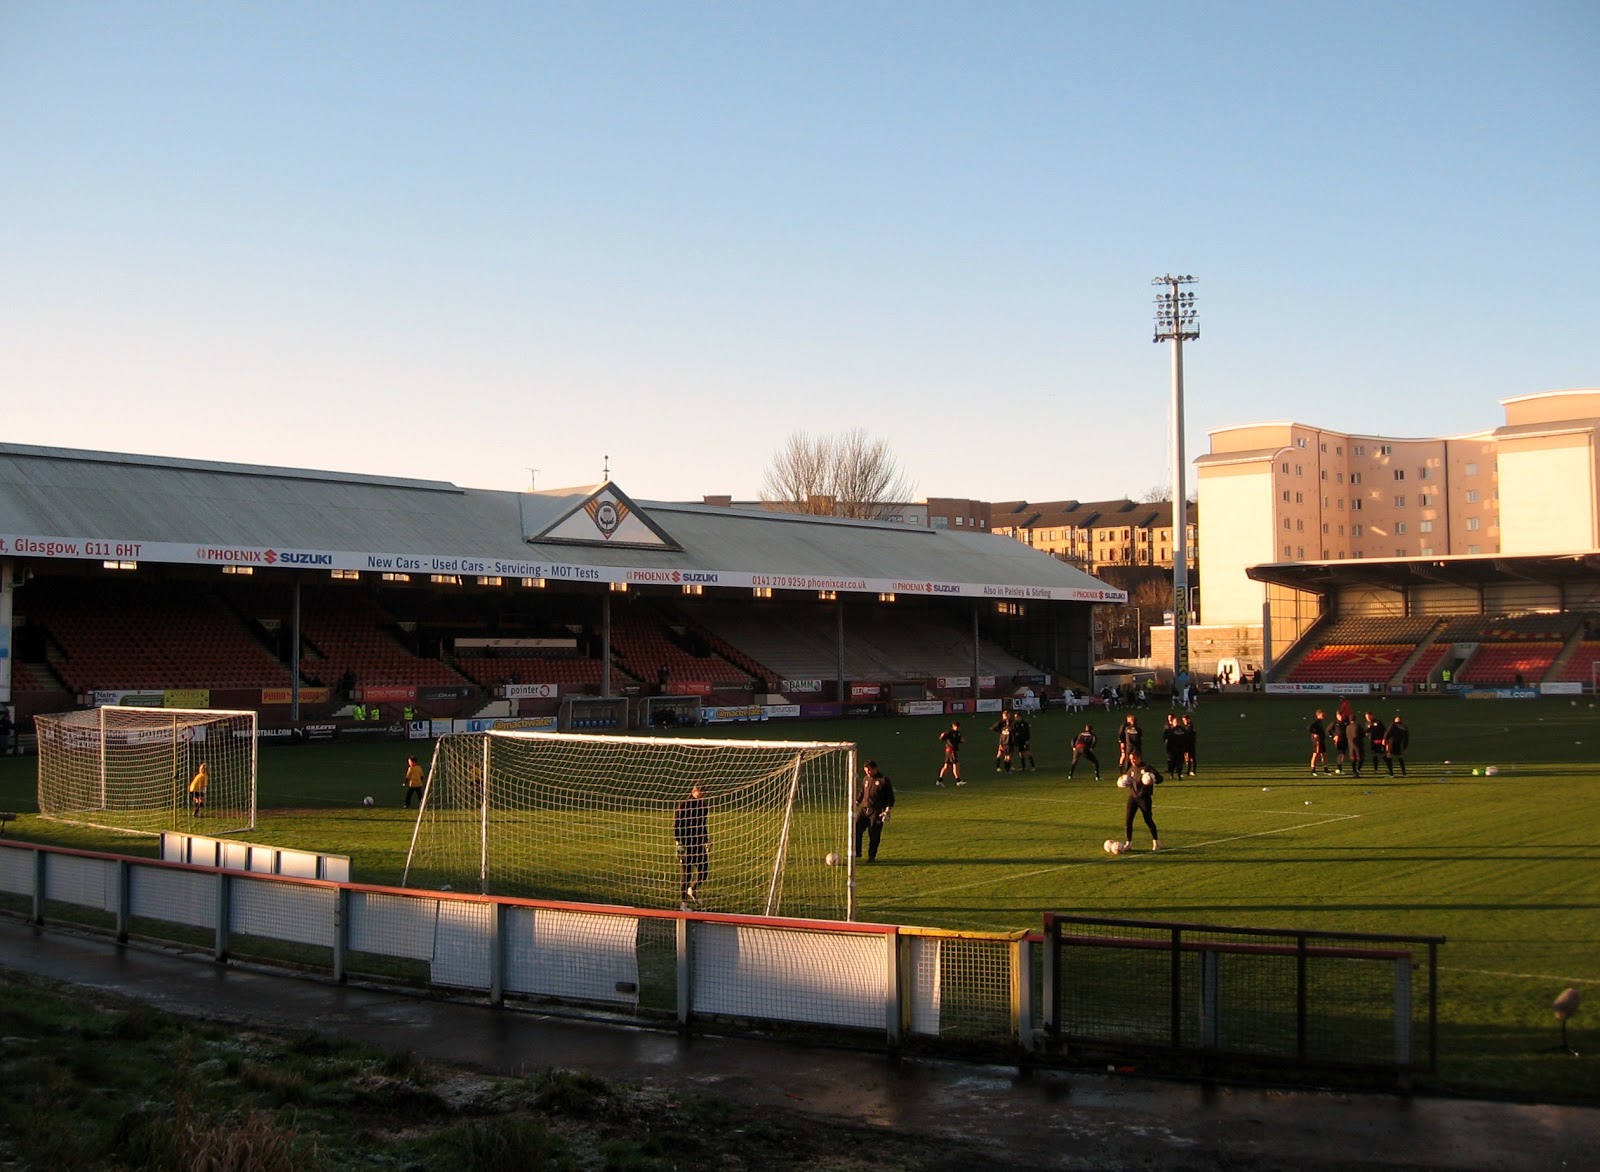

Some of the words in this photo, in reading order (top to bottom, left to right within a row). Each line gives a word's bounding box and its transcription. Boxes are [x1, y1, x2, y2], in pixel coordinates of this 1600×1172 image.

[15, 539, 79, 556] Glasgow,
[85, 542, 110, 555] G11
[116, 544, 142, 557] 6HT
[207, 549, 261, 562] PHOENIX
[280, 552, 332, 565] SUZUKI
[368, 556, 392, 568] New
[396, 557, 420, 569] Cars
[432, 558, 458, 571] Used
[461, 560, 484, 572] Cars
[495, 562, 541, 577] Servicing
[551, 565, 572, 577] MOT
[575, 567, 599, 579] Tests
[633, 571, 670, 582] PHOENIX
[683, 573, 718, 583] SUZUKI
[752, 575, 770, 586] 0141
[772, 576, 786, 587] 270
[788, 577, 806, 588] 9250
[807, 578, 867, 590] phoenixcar.co.uk
[897, 583, 925, 592] PHOENIX
[934, 585, 960, 593] SUZUKI
[984, 586, 996, 596] Also
[997, 587, 1004, 596] in
[1005, 587, 1025, 598] Paisley
[1026, 588, 1031, 597] &
[1032, 588, 1052, 599] Stirling
[1076, 591, 1098, 599] PHOENIX
[1105, 592, 1126, 600] SUZUKI
[510, 686, 539, 696] pointer
